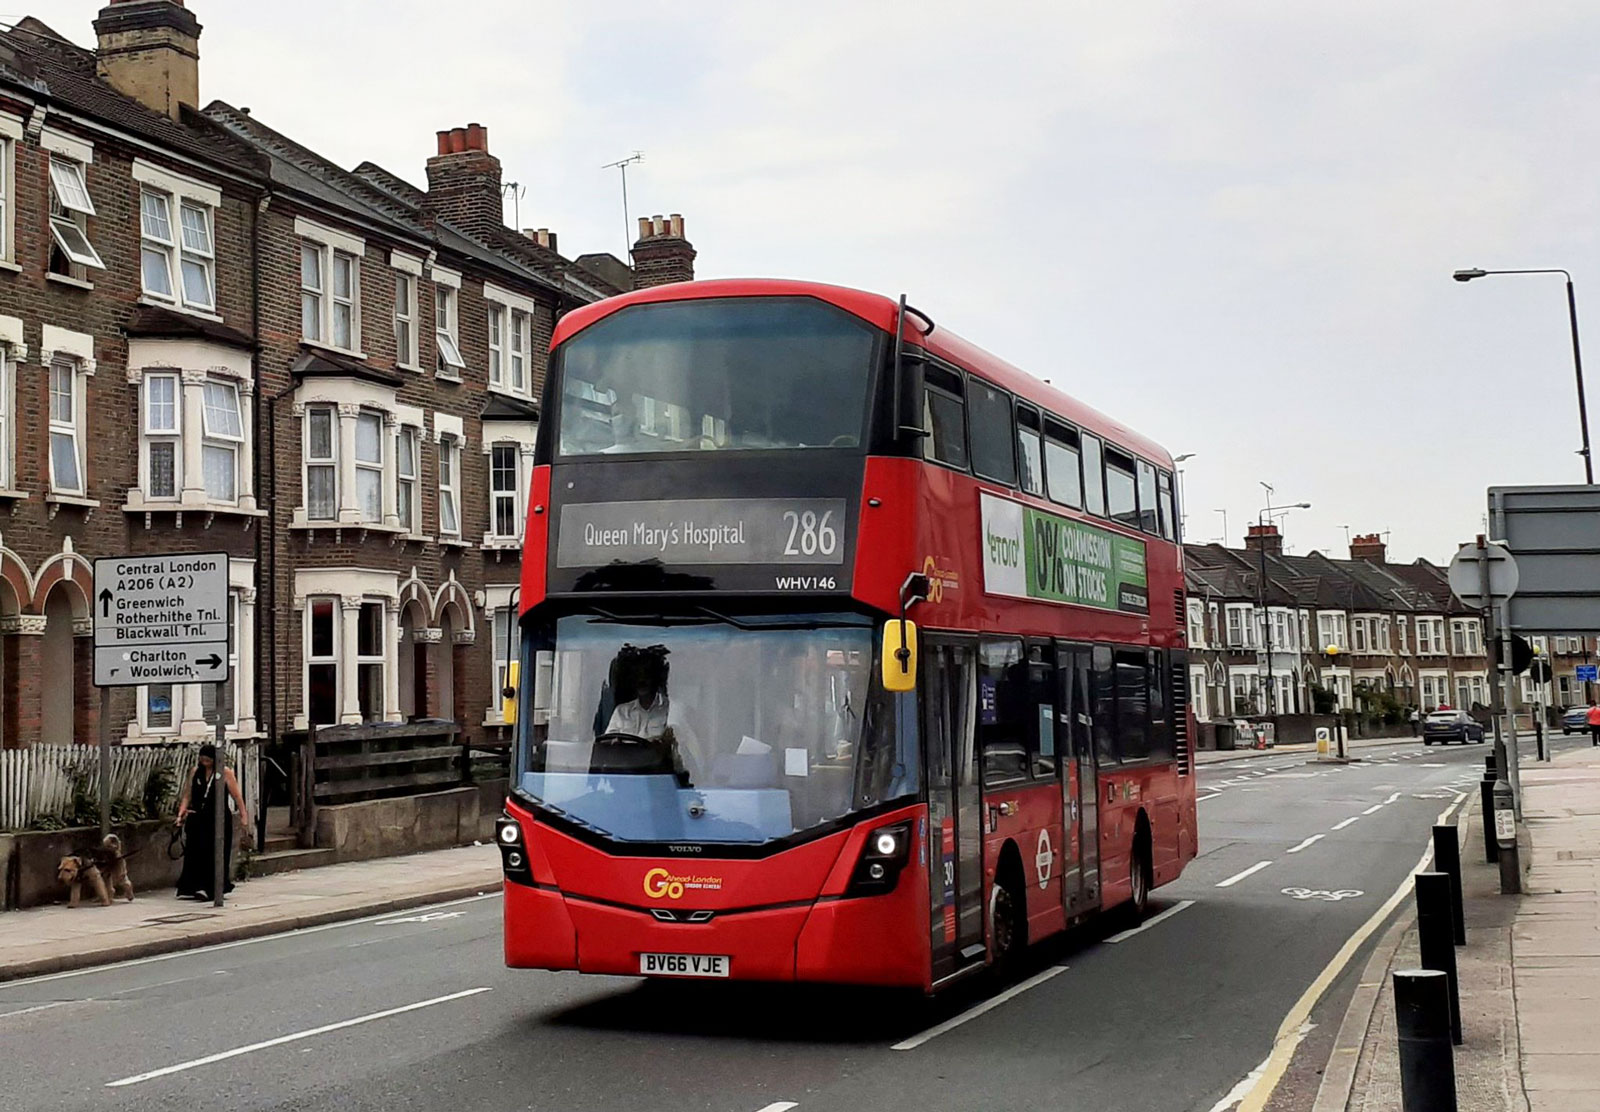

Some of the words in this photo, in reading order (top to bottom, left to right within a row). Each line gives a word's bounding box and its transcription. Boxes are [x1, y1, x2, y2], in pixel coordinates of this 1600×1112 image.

[585, 523, 628, 546] Queen
[633, 522, 679, 551] Mary's
[684, 520, 745, 551] Hospital
[783, 510, 836, 556] 286
[1035, 518, 1064, 594] 0%
[1062, 526, 1111, 570] COMMISSION
[117, 562, 164, 576] Central
[170, 560, 217, 573] London
[117, 578, 154, 591] A206
[159, 575, 194, 590] (A2)
[775, 576, 836, 590] WHV146
[1064, 563, 1077, 598] ON
[1077, 566, 1107, 603] STOCKS
[116, 596, 185, 610] Greenwich
[117, 611, 192, 624] Rotherhithe
[197, 609, 221, 621] Tnl.
[117, 624, 179, 639] Blackwall
[183, 624, 207, 636] Tnl.
[130, 650, 187, 663] Charlton
[130, 664, 192, 678] Woolwich
[669, 845, 702, 853] VOLVO
[692, 875, 722, 885] London
[944, 861, 954, 886] 30
[643, 867, 684, 899] Go
[647, 955, 687, 971] BV66
[692, 957, 722, 973] VJE
